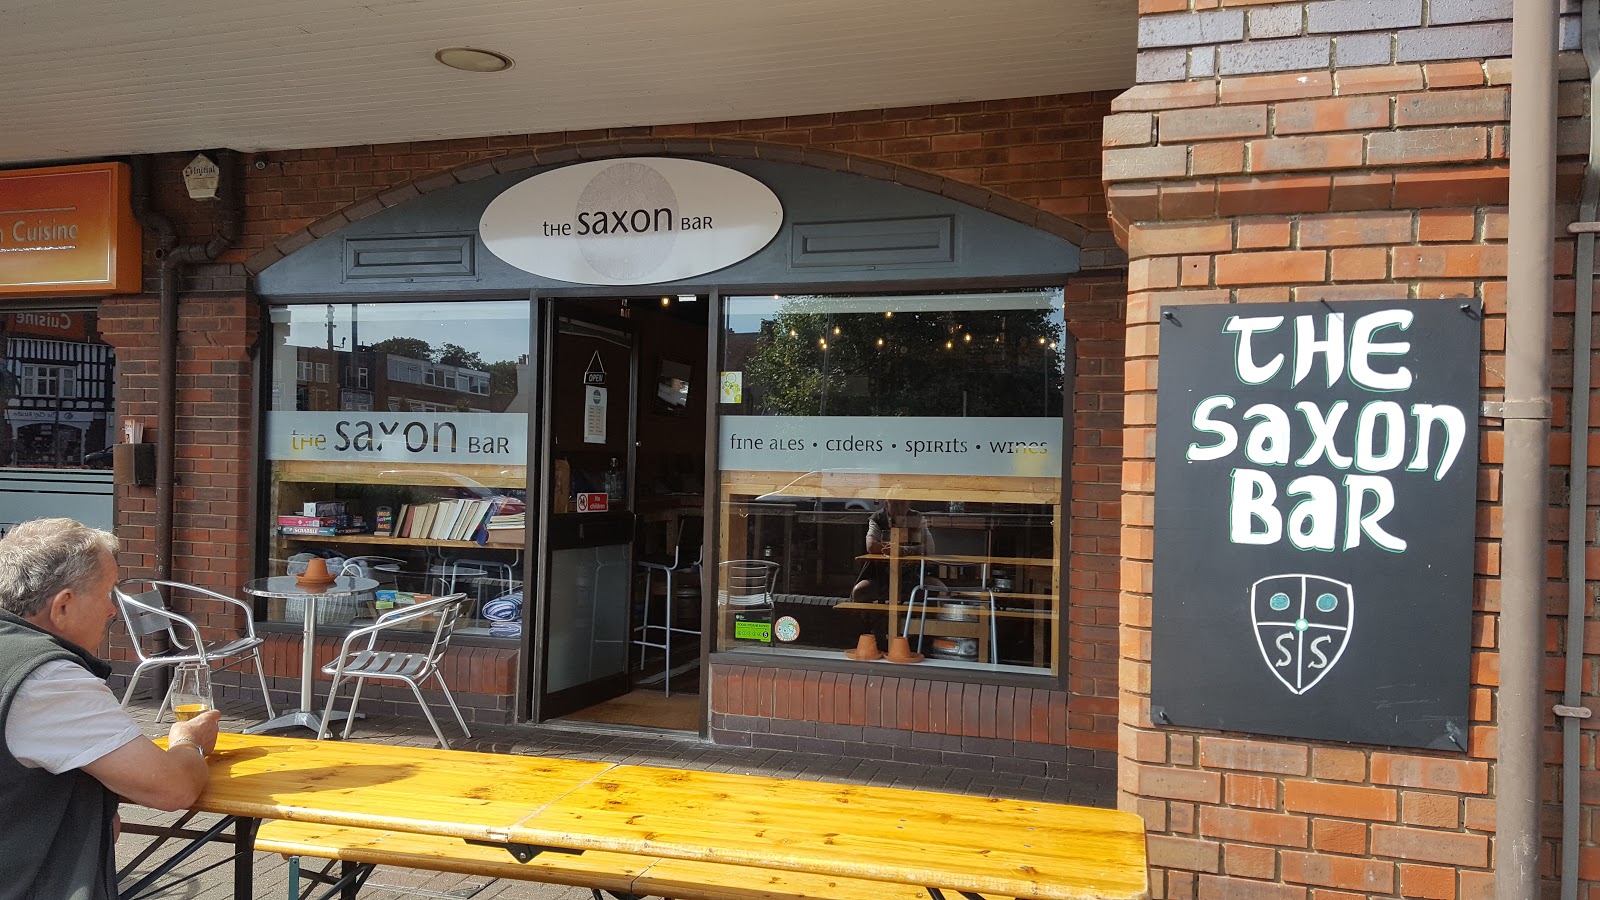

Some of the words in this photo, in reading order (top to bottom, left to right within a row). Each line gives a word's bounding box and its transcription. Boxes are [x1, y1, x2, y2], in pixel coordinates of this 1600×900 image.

[193, 165, 215, 175] Initial
[12, 218, 79, 243] Cuisine
[576, 206, 673, 236] saxon
[1222, 309, 1414, 393] THE
[588, 373, 604, 383] OPEN
